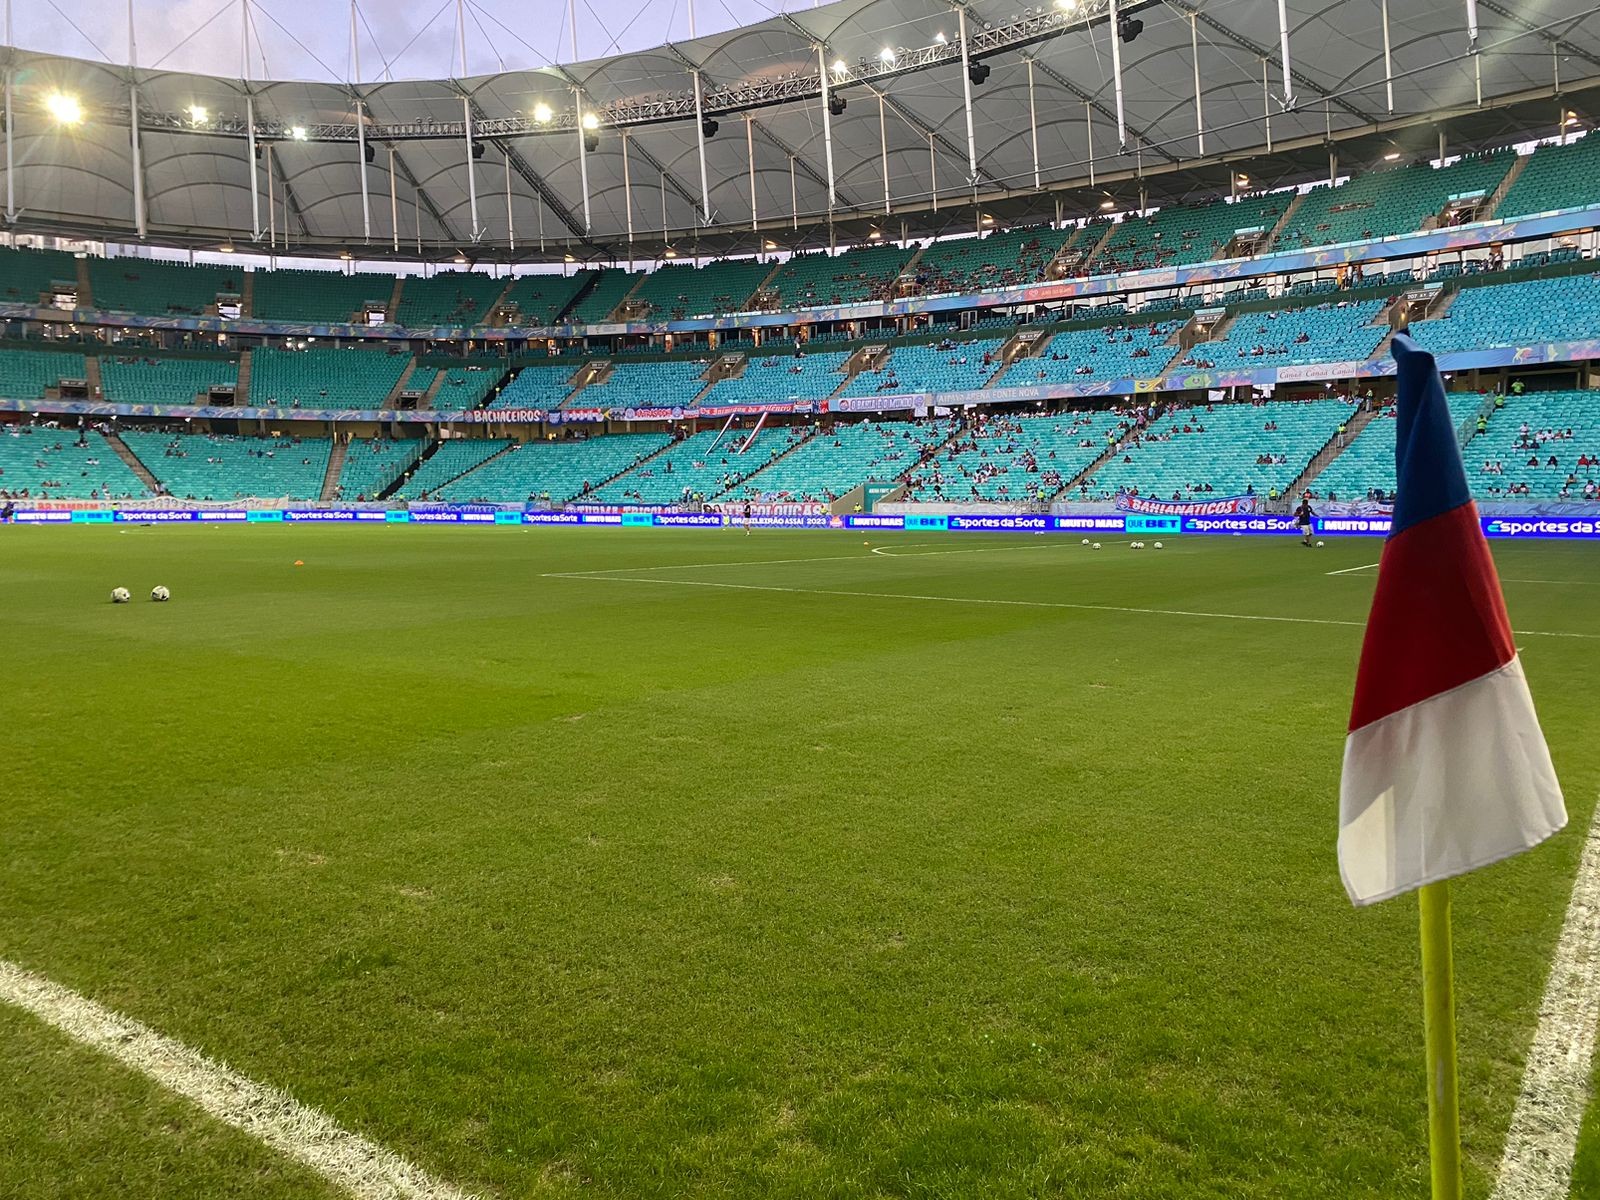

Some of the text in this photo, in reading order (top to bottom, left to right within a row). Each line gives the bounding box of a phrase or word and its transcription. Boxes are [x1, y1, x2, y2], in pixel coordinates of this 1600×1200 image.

[992, 390, 1017, 399] FONTE
[1018, 388, 1039, 398] NOVA
[473, 410, 541, 422] BACHACEIROS
[699, 515, 719, 524] Sorte
[806, 517, 827, 525] 2023
[881, 517, 904, 526] MAIS
[1000, 517, 1014, 527] da
[1015, 517, 1046, 527] Sorte
[1060, 518, 1094, 528] MUITO
[1095, 518, 1124, 528] MAIS
[1128, 519, 1179, 528] QUE BET
[1247, 518, 1266, 529] da
[1324, 520, 1369, 531] MUITO
[1487, 520, 1568, 535] Esportes
[1569, 520, 1593, 533] da
